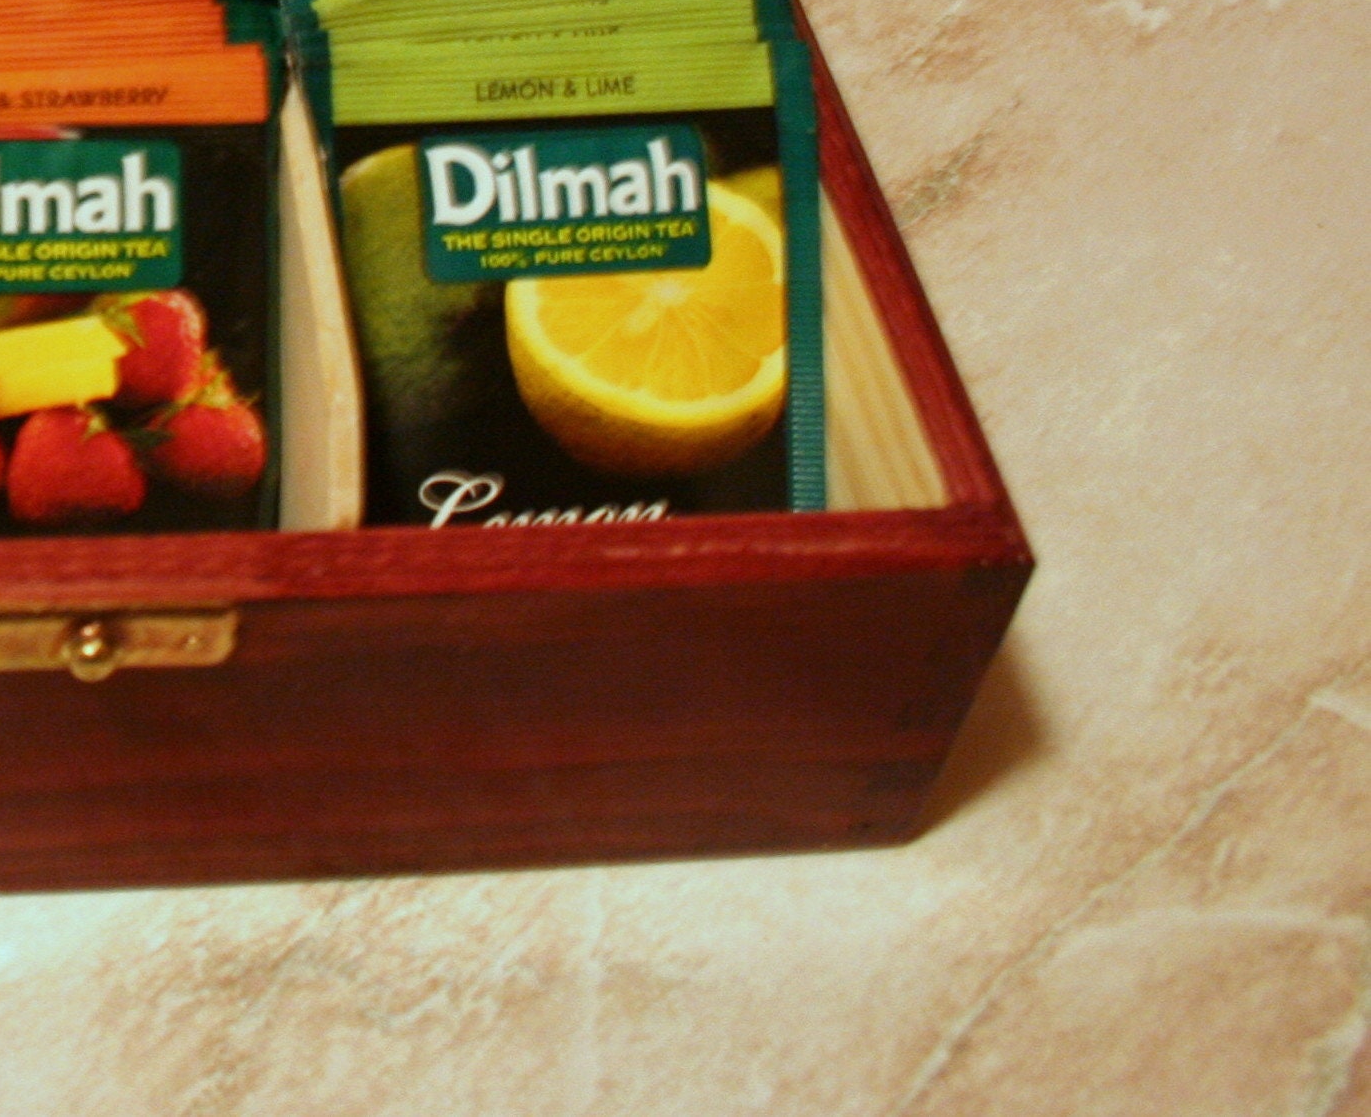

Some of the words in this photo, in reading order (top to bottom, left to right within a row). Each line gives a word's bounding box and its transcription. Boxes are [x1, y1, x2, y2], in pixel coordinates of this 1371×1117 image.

[20, 85, 170, 110] STRAWBERRY
[474, 79, 555, 103] LEMON
[562, 79, 577, 98] &
[585, 75, 636, 97] LIME
[424, 137, 701, 226] Dilmah
[442, 232, 489, 252] THE
[491, 227, 573, 248] SINGLE
[575, 223, 650, 244] ORIGIN
[655, 220, 696, 239] TEA
[34, 239, 120, 261] ORIGIN
[123, 238, 170, 259] TEA
[534, 248, 586, 265] PURE
[589, 243, 665, 262] CEYLON
[49, 262, 134, 281] CEYLON
